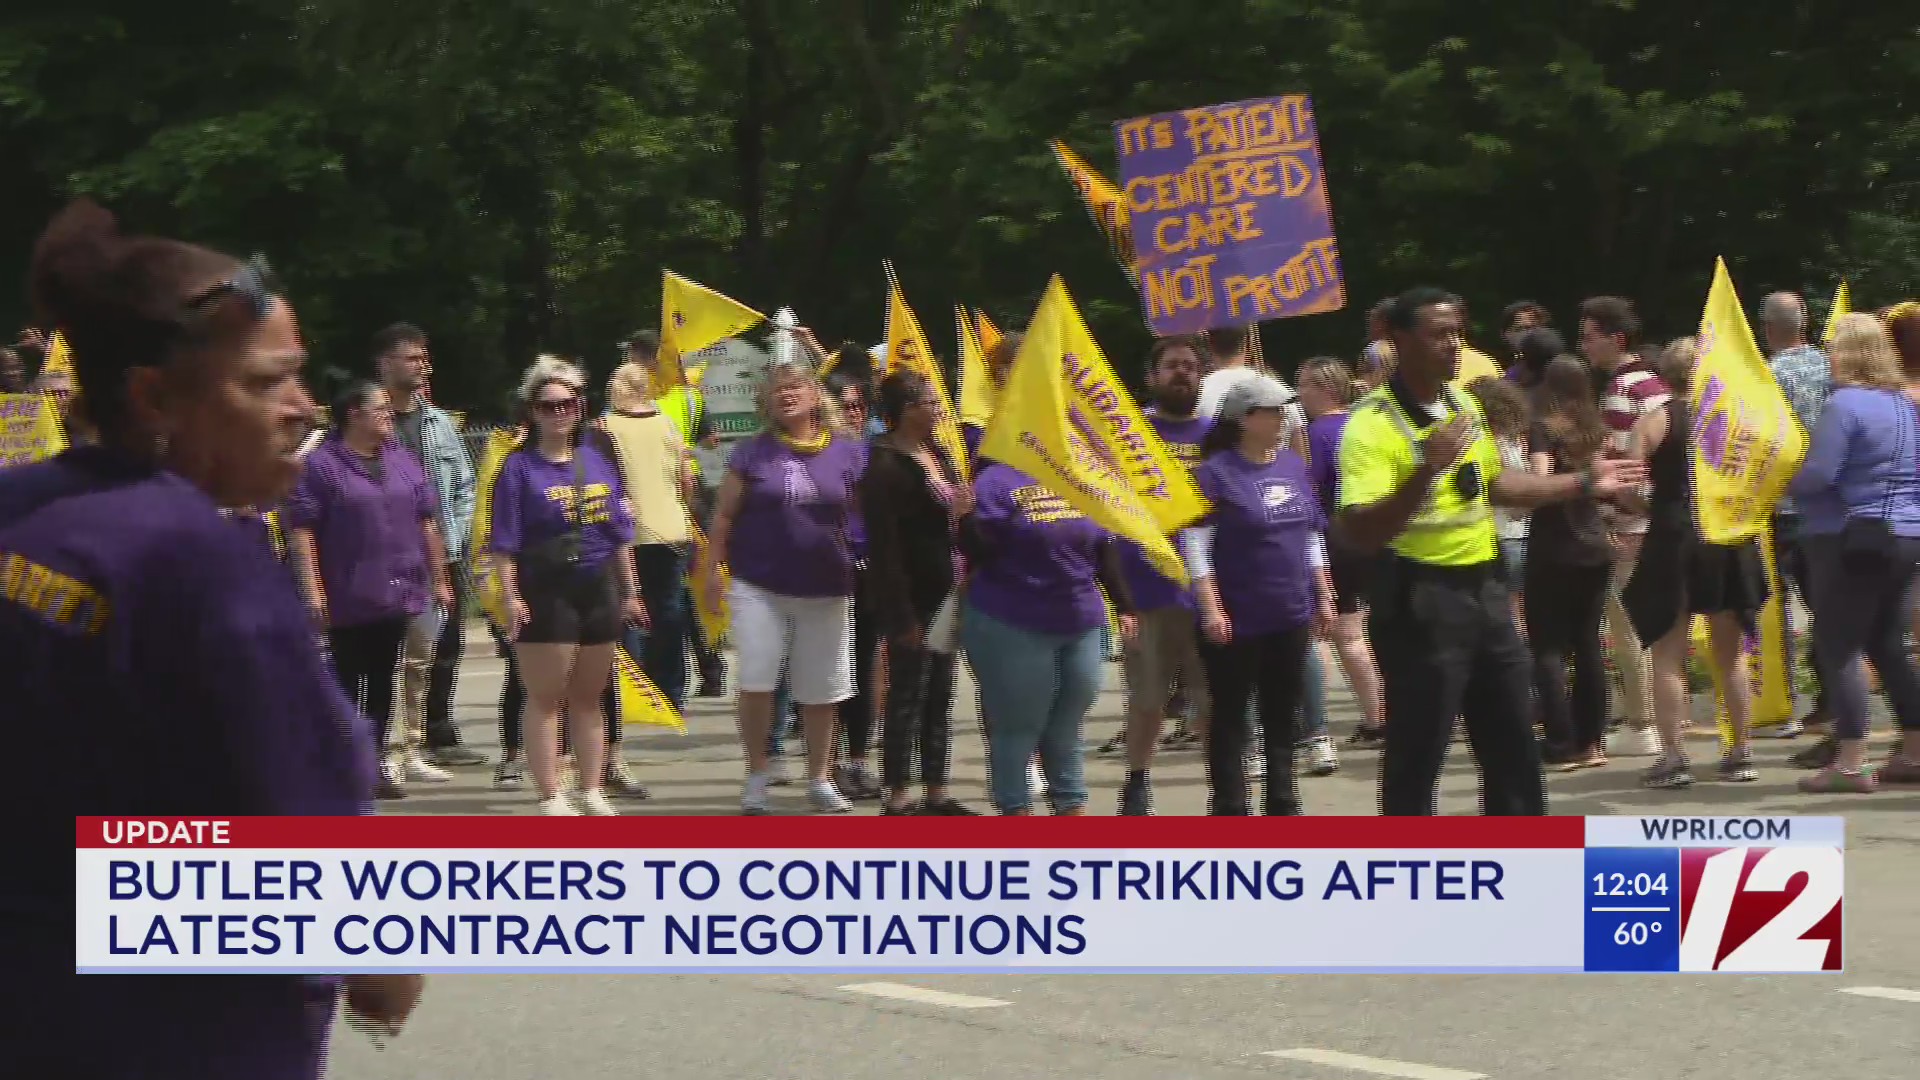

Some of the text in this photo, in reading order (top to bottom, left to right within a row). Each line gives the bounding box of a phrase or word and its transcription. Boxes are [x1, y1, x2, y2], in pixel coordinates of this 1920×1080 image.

[1182, 94, 1309, 155] PATIENT
[1126, 156, 1312, 213] CENTERED
[1154, 202, 1263, 253] CARE
[1143, 237, 1339, 318] NOT PROFIT
[1060, 352, 1172, 501] OLIDARITY
